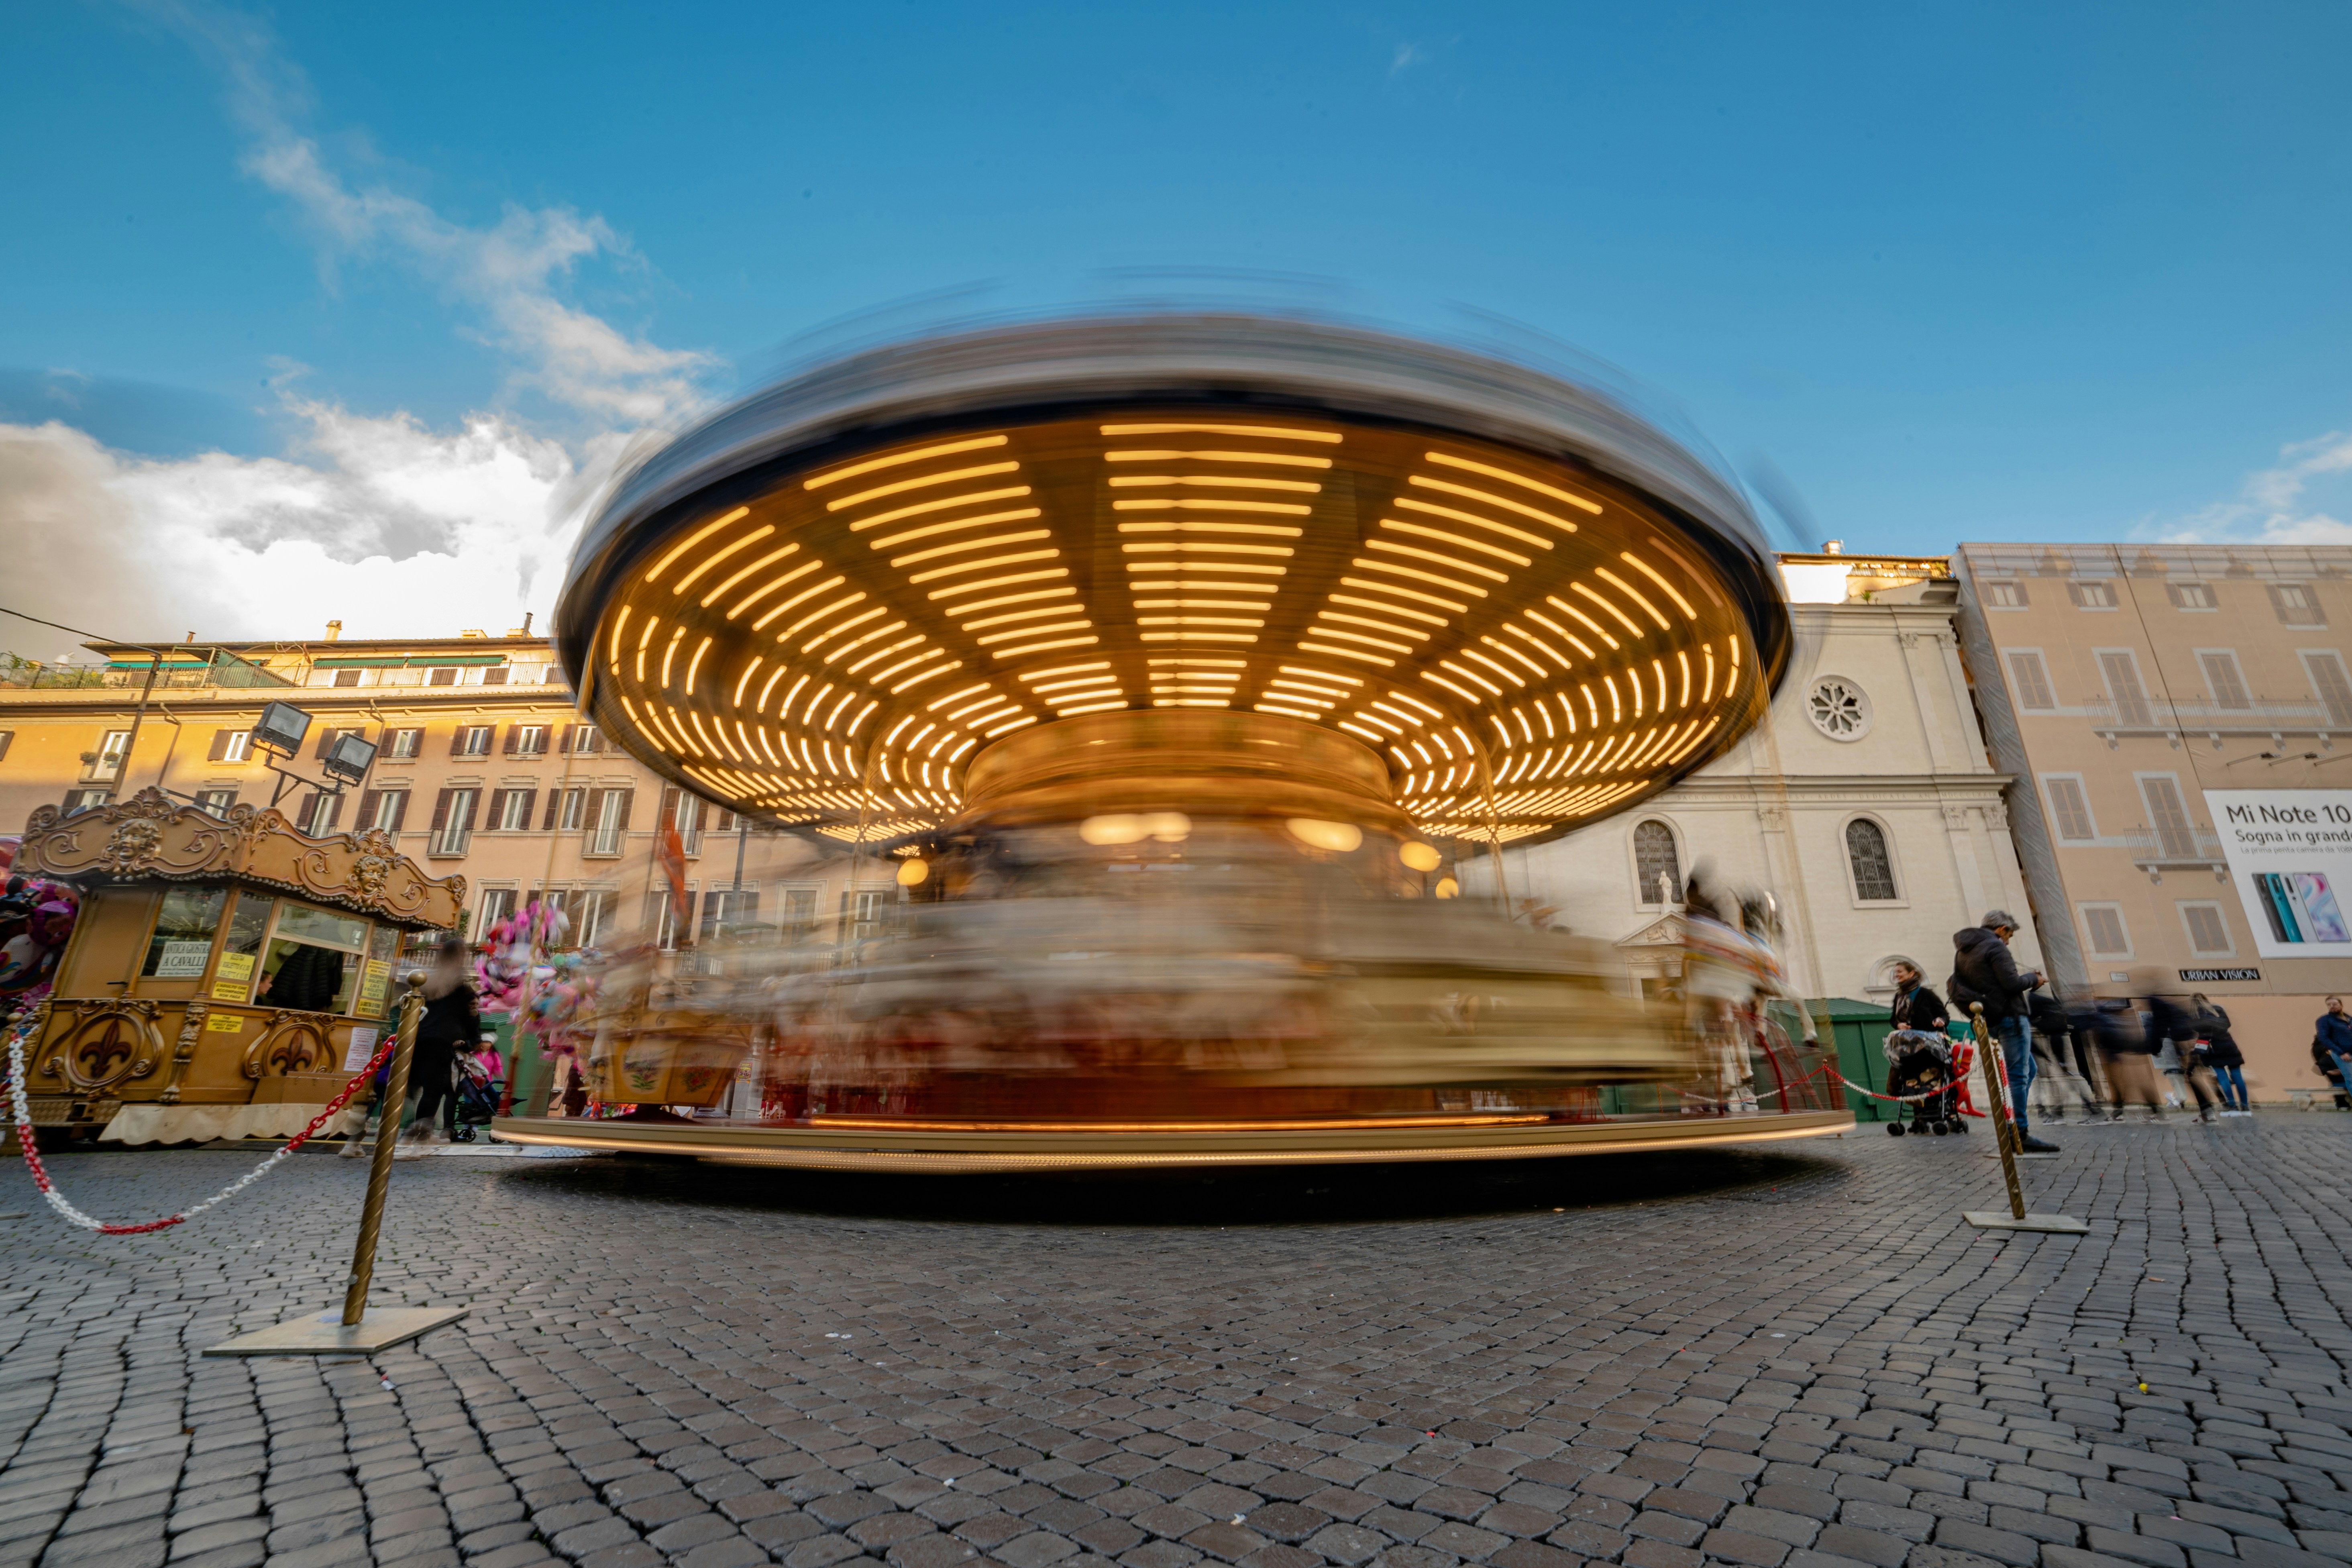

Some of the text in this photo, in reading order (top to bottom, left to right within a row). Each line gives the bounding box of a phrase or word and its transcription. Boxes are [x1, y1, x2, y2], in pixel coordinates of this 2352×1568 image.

[2226, 804, 2351, 824] Mi Note 10
[2235, 829, 2352, 846] Sogna in grand
[2250, 846, 2272, 855] prima
[2273, 846, 2295, 855] penta
[2296, 846, 2324, 854] camera
[2325, 845, 2335, 854] da
[162, 956, 207, 966] A CAVALLI
[2181, 969, 2258, 981] URBAN VISION
